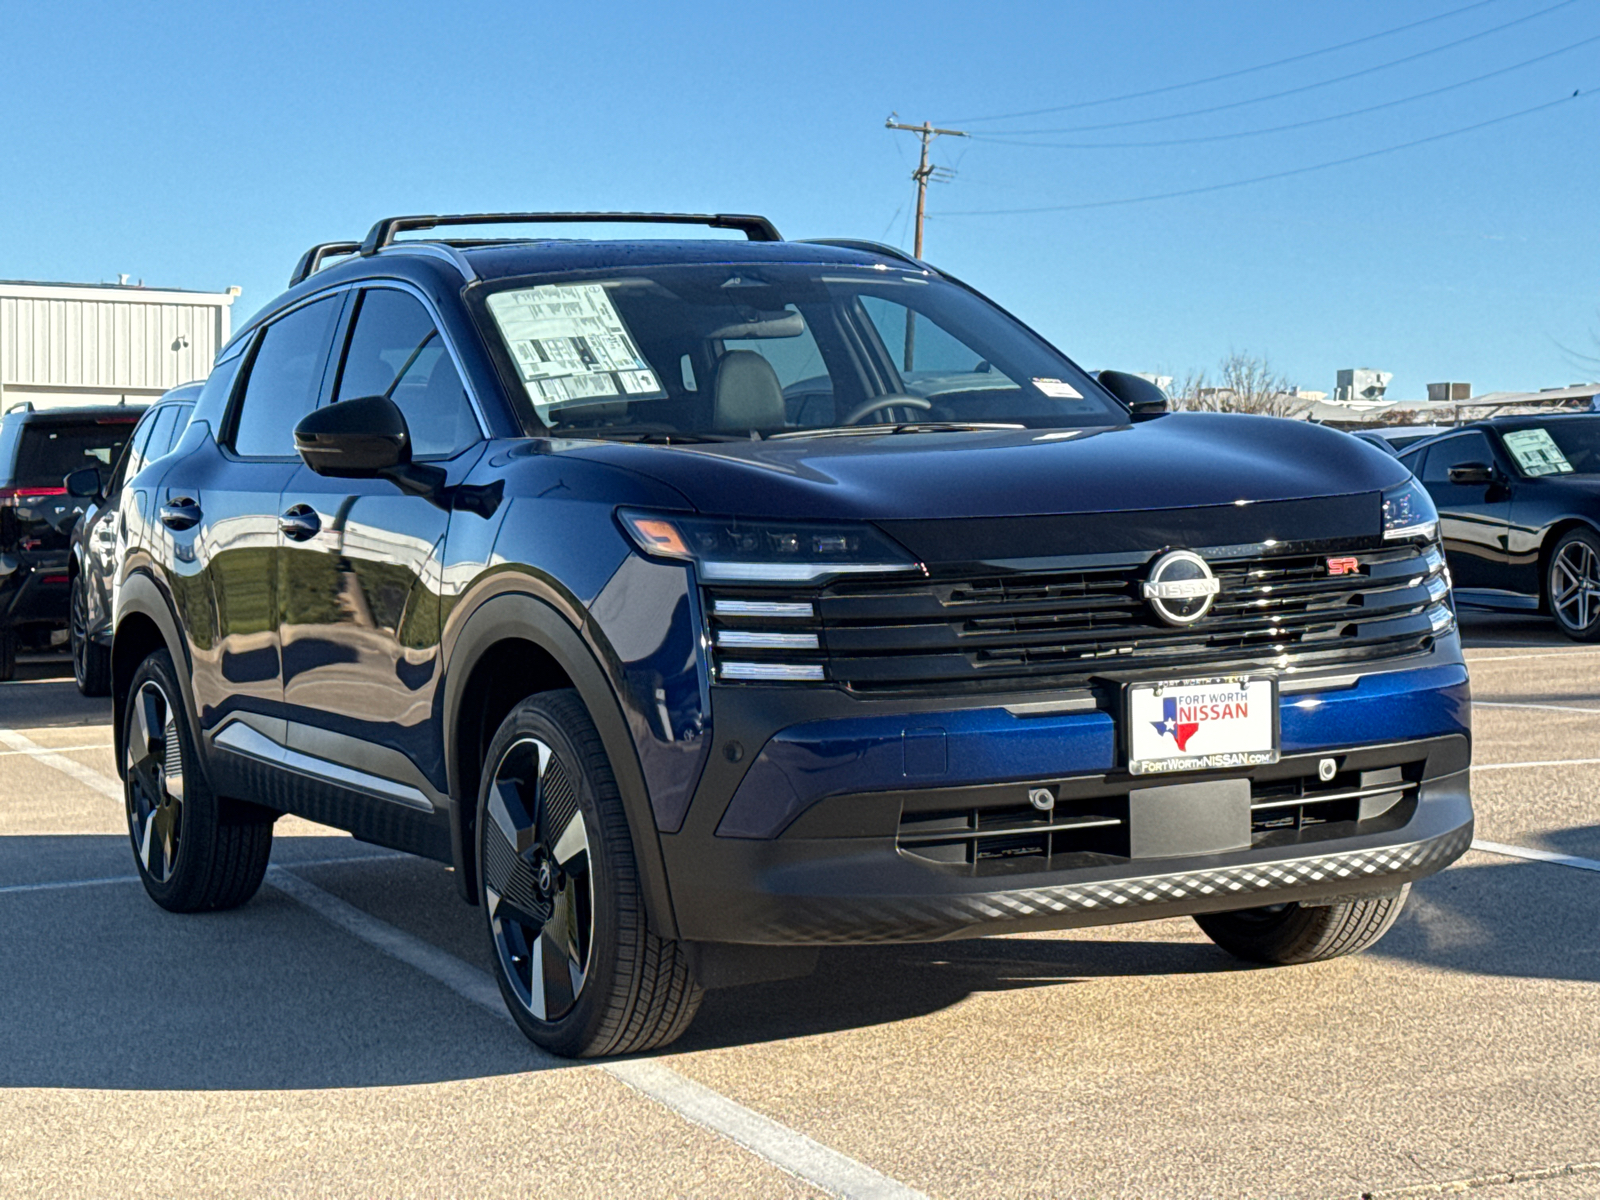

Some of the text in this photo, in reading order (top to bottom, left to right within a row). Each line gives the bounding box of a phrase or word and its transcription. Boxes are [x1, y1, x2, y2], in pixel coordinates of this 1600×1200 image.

[1328, 557, 1359, 575] SR
[1145, 580, 1217, 598] NISSAN
[1179, 692, 1248, 705] FORT WORTH
[1179, 703, 1248, 722] NISSAN
